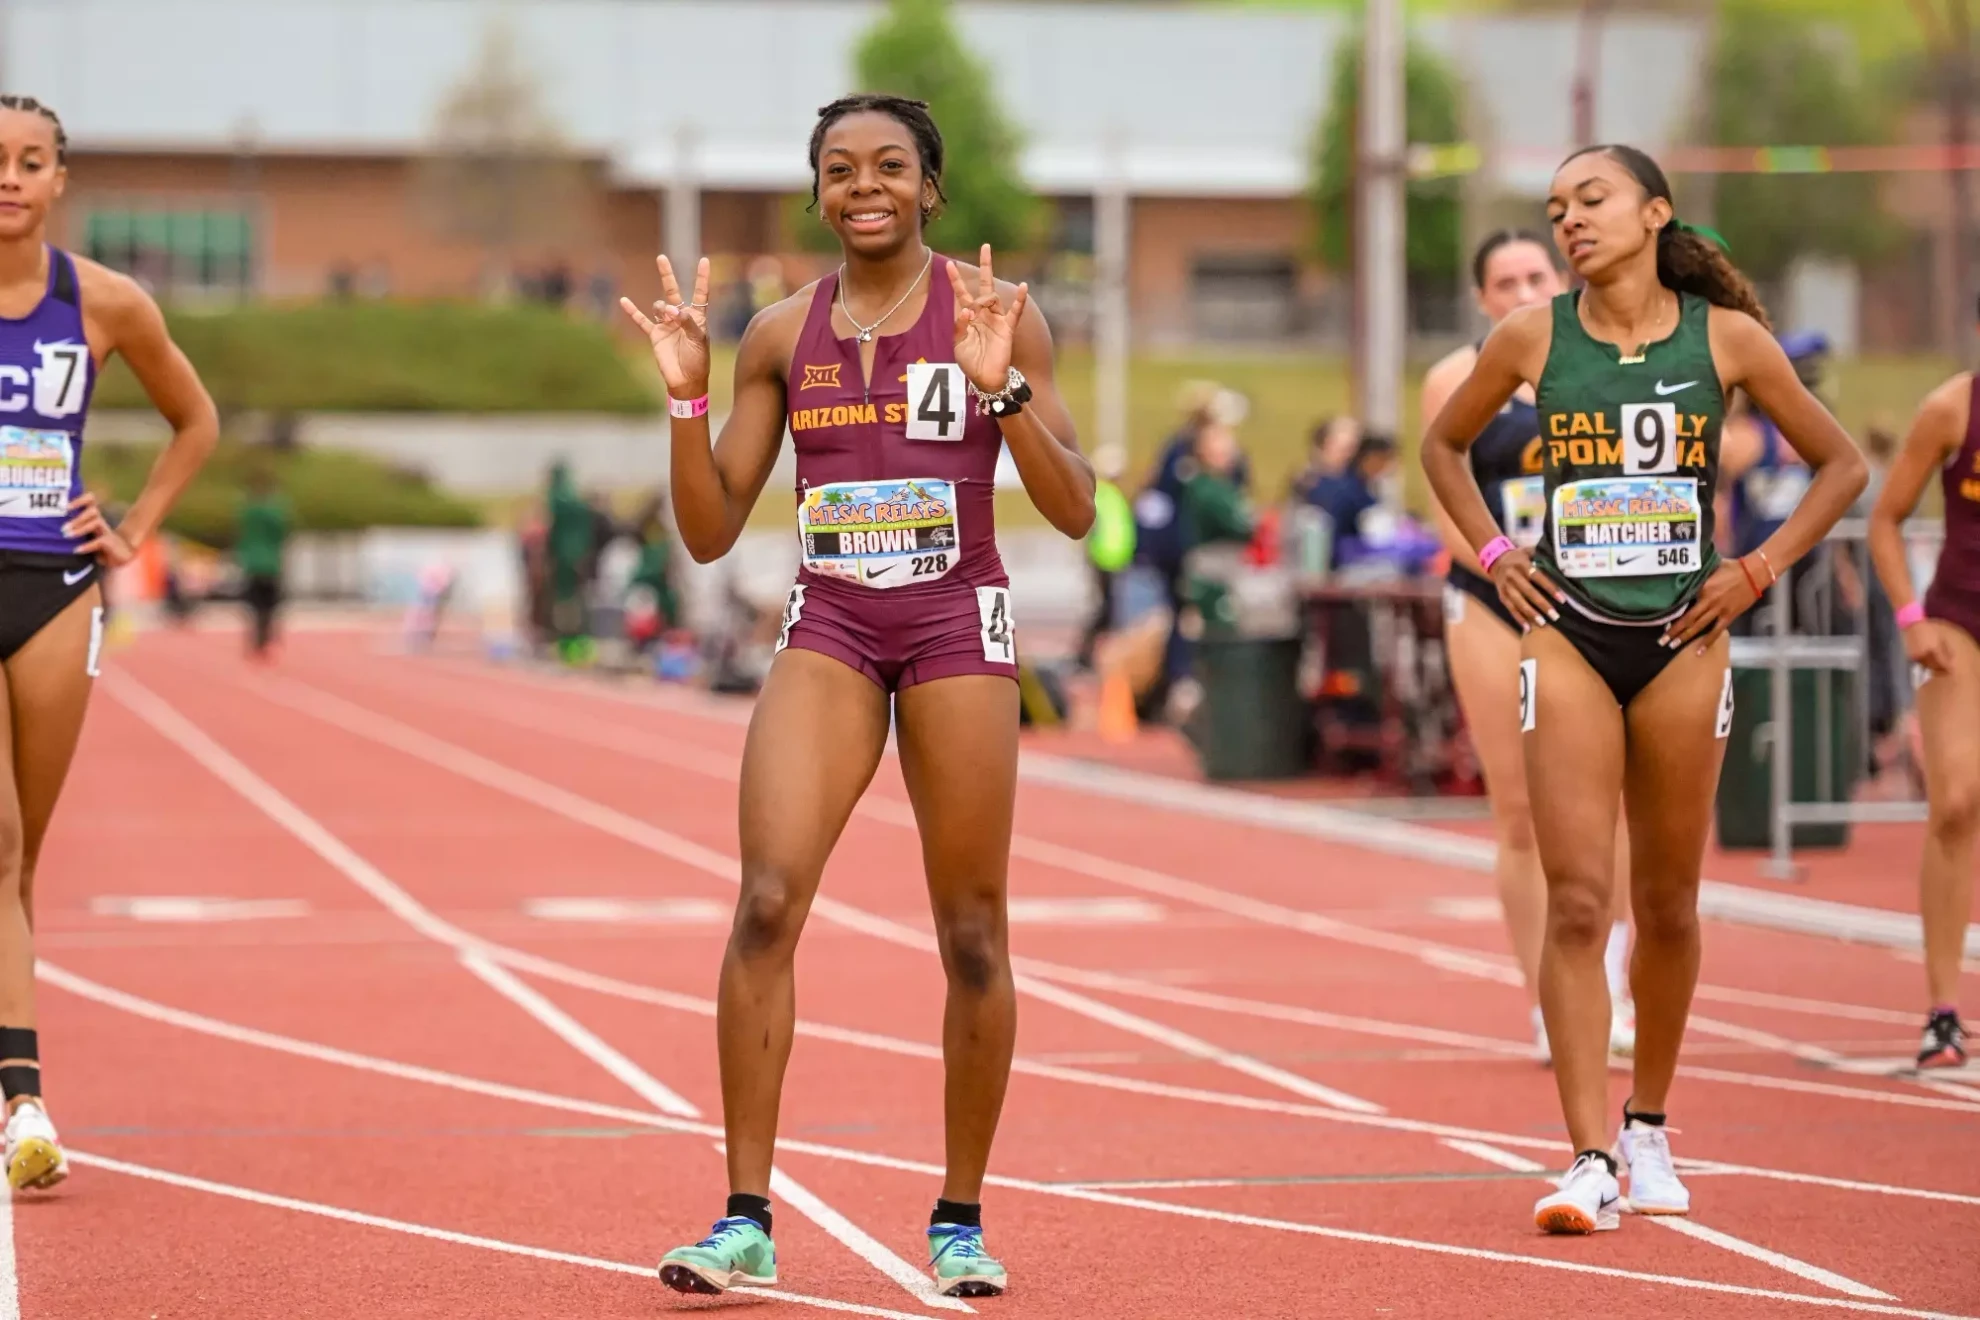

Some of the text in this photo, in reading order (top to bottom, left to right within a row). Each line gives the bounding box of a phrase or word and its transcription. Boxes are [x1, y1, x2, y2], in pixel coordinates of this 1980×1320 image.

[53, 351, 78, 407] 7
[917, 368, 956, 436] 4
[792, 404, 879, 431] ARIZONA
[1550, 412, 1708, 437] CAL LY
[1634, 408, 1666, 470] 9
[1548, 438, 1706, 468] POMA
[875, 500, 947, 523] RELAYS
[839, 528, 918, 555] BROWN
[1584, 521, 1671, 545] HATCHER
[911, 553, 948, 576] 228
[1657, 547, 1690, 566] 546
[988, 592, 1009, 658] 4
